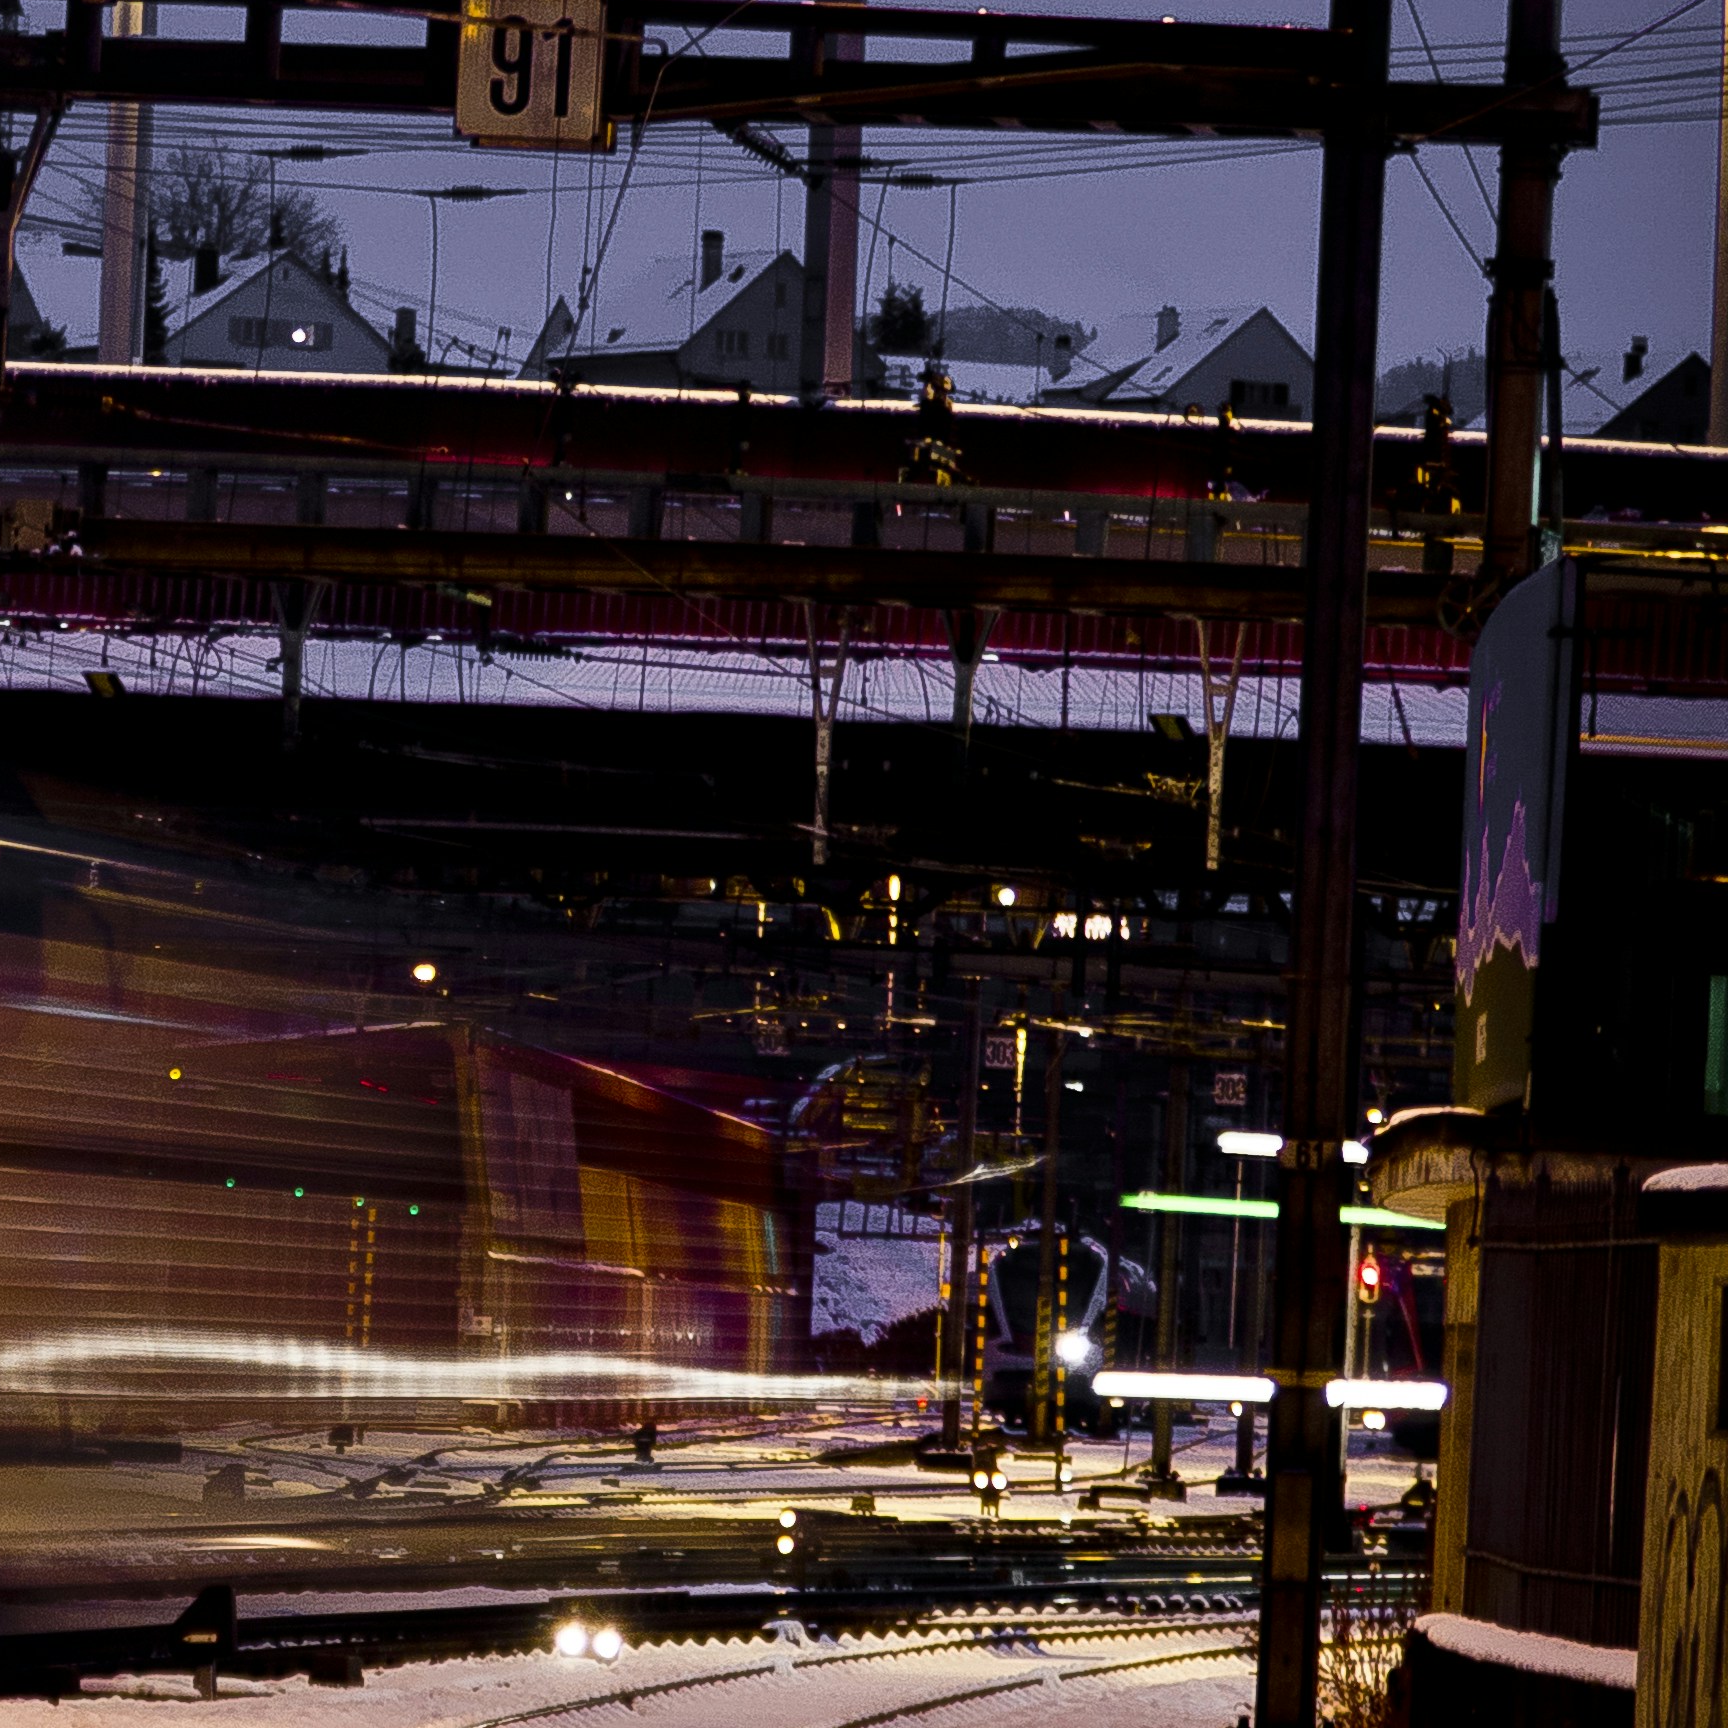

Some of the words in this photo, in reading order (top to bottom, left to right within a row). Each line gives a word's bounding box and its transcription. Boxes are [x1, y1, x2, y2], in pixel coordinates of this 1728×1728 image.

[489, 15, 573, 117] 91
[986, 1040, 1015, 1065] 303
[1215, 1077, 1246, 1102] 302
[1297, 1141, 1323, 1170] 61
